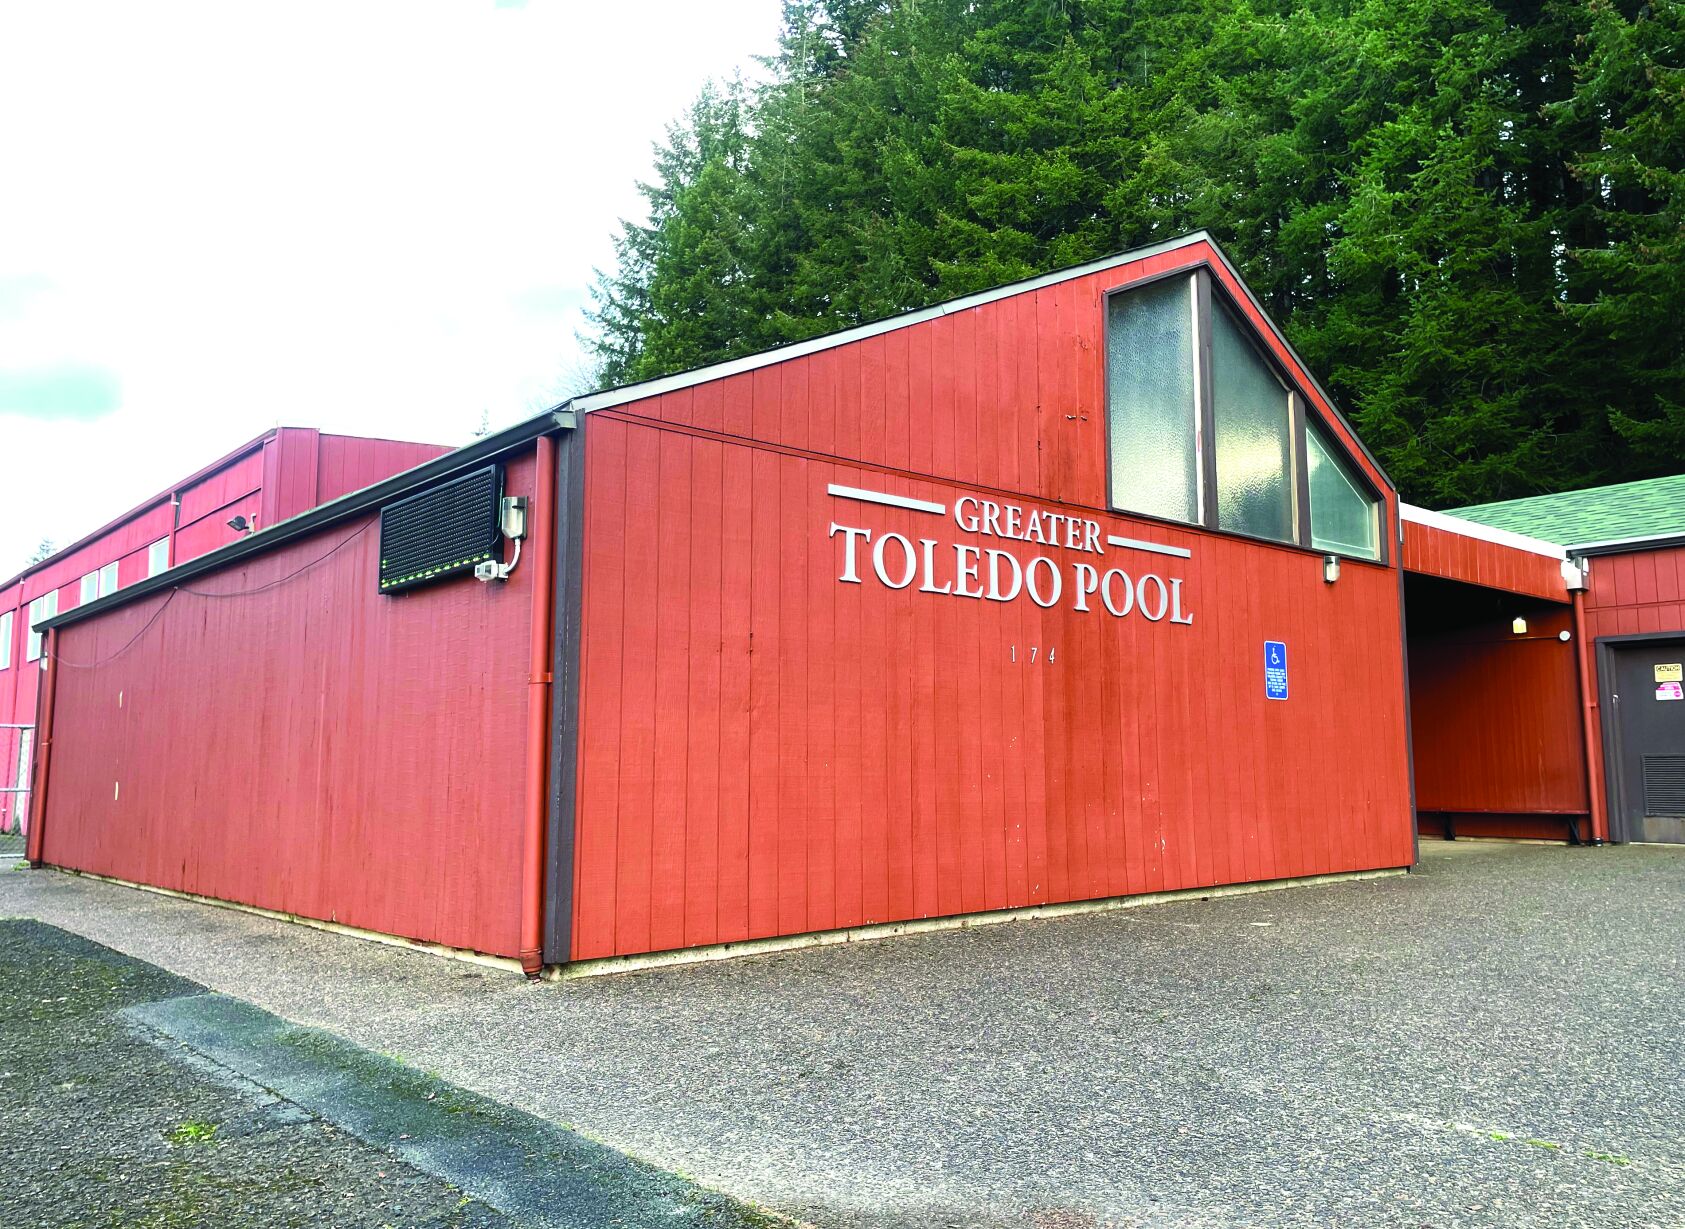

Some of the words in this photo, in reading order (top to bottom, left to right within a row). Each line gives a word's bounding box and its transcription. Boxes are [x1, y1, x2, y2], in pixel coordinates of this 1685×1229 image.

[954, 497, 1104, 554] GREATER
[829, 522, 1062, 607] TOLEDO
[1072, 562, 1194, 625] POOL
